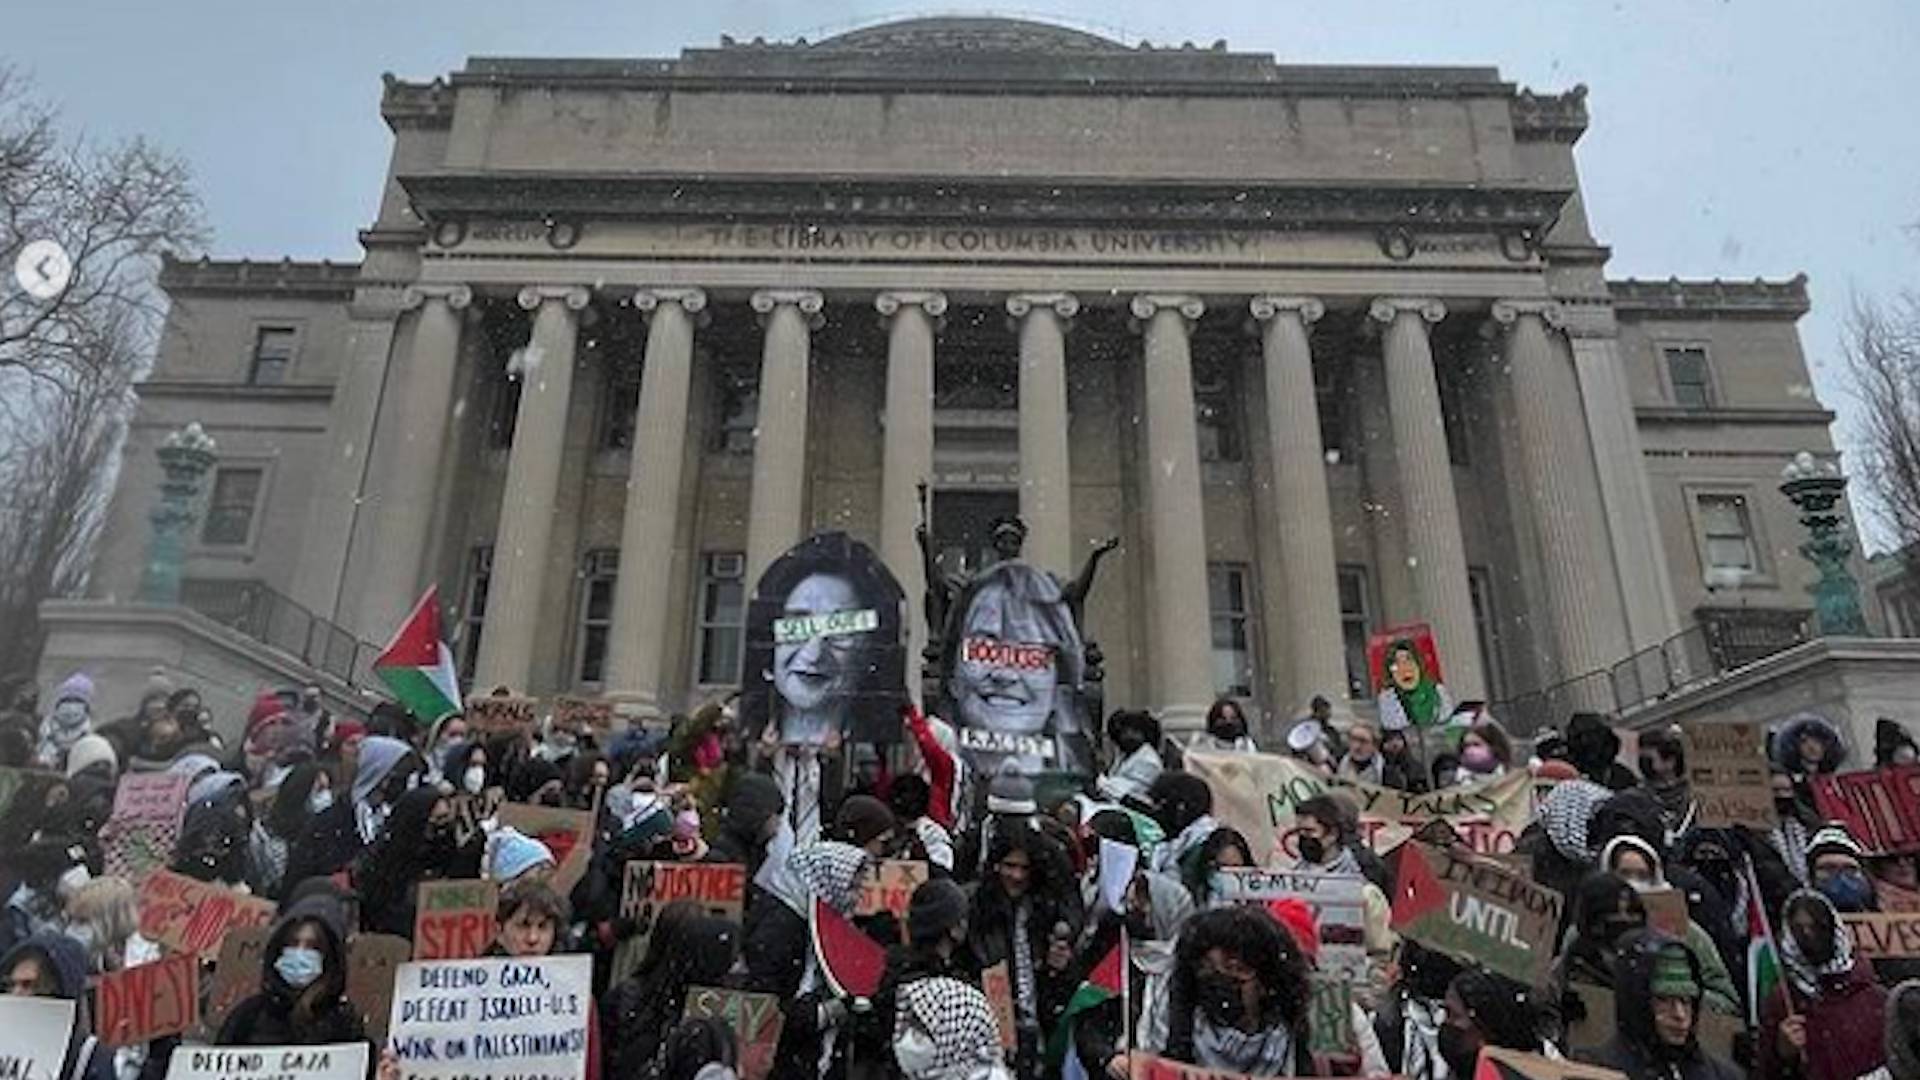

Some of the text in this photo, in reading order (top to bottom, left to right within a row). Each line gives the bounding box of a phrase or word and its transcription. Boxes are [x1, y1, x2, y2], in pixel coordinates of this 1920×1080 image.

[707, 229, 1254, 252] THE LIBRARY OF COLUMBIA UNIVERSITY
[420, 964, 551, 989] DEFEND GAZA,
[401, 1000, 467, 1023] DEFEAT
[392, 1035, 440, 1060] WAR
[444, 1039, 467, 1059] ON
[192, 1053, 331, 1072] DEFEND GAZA
